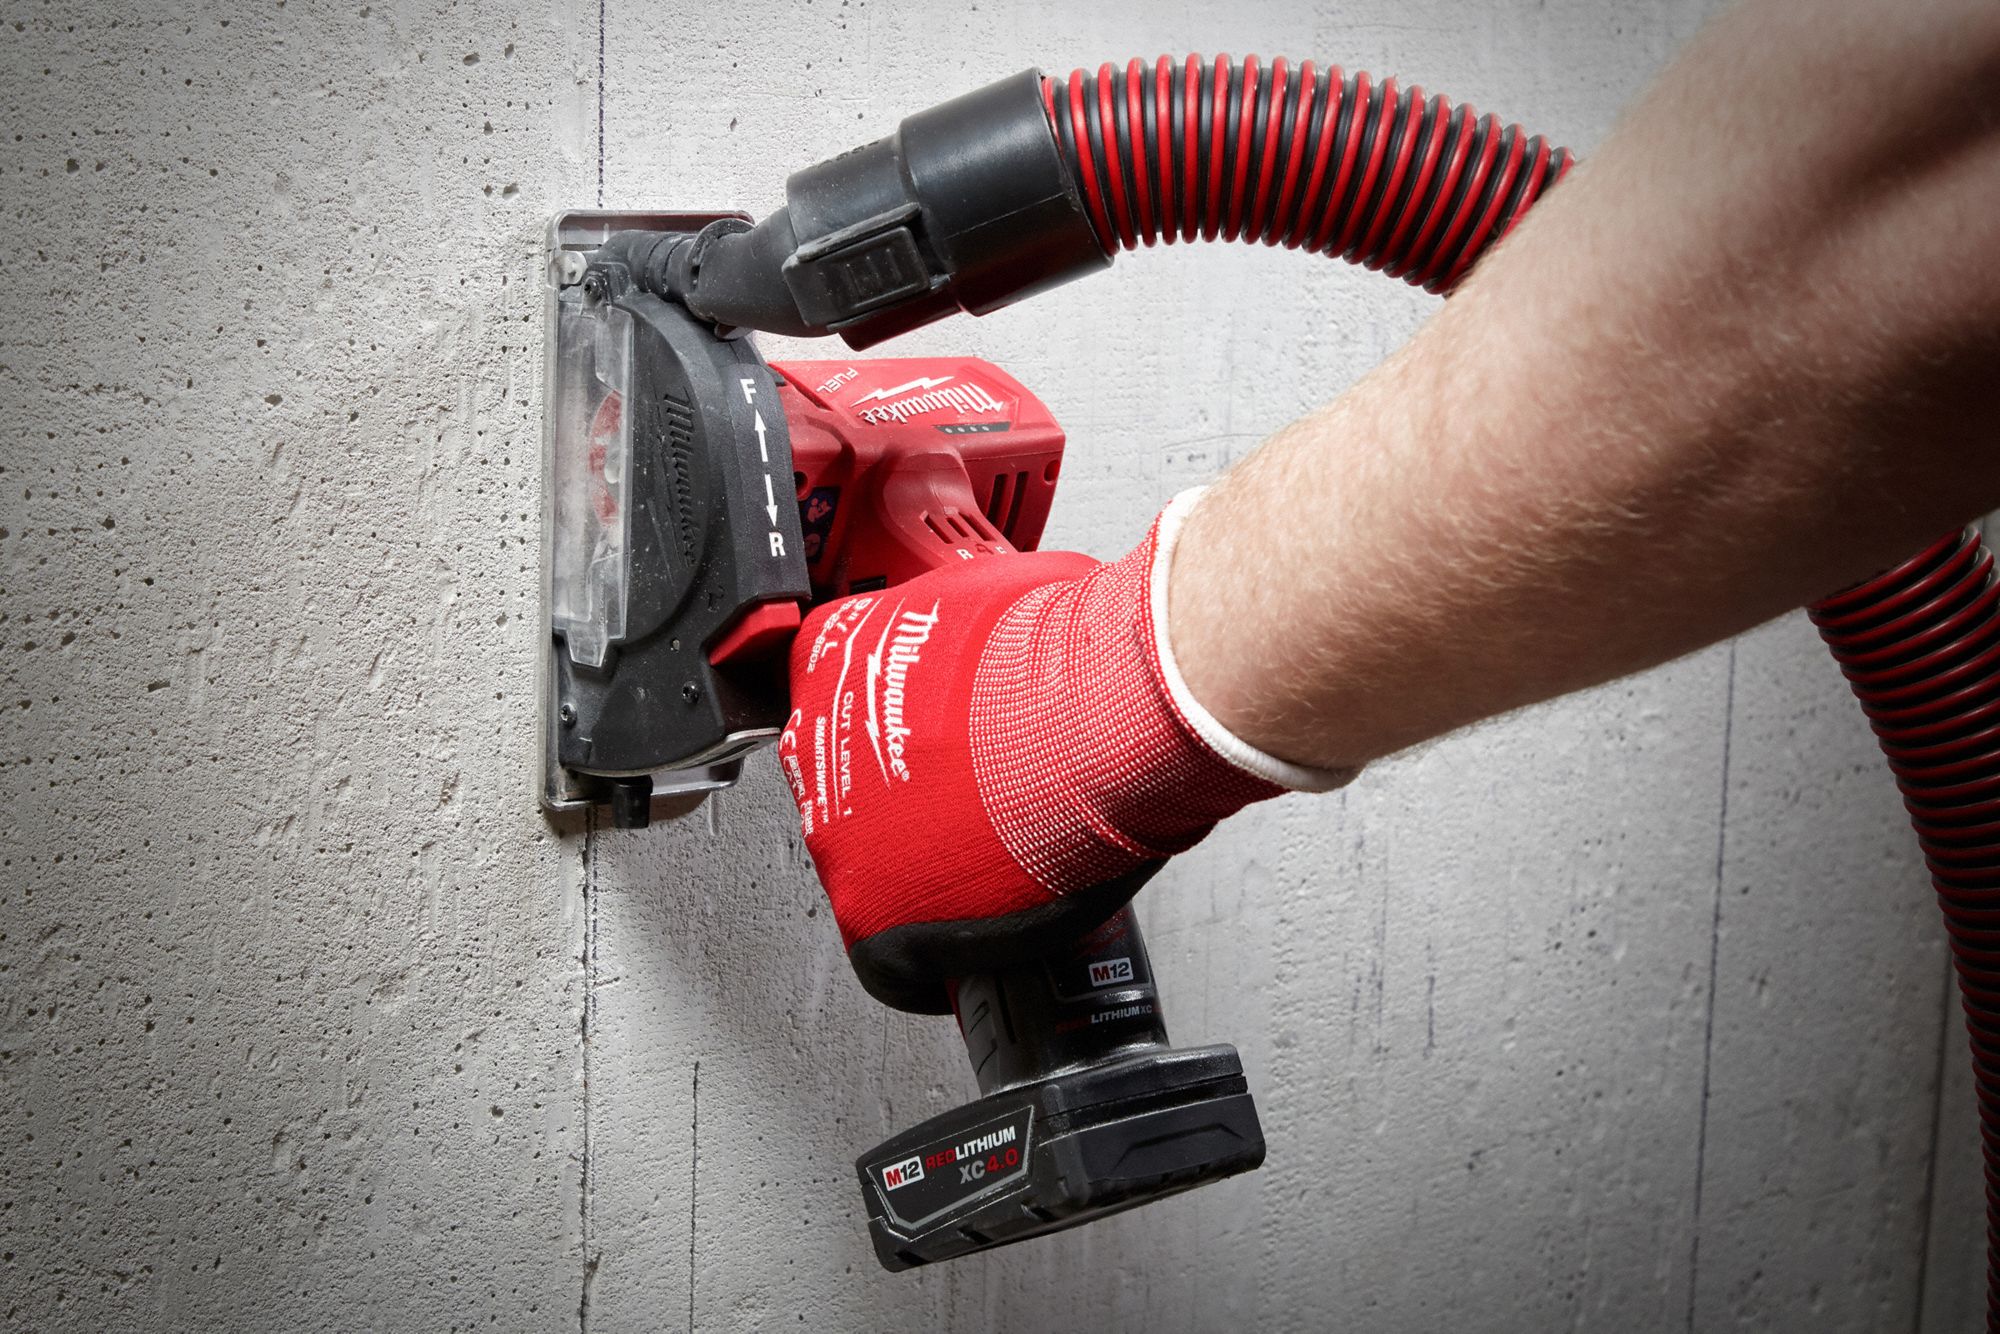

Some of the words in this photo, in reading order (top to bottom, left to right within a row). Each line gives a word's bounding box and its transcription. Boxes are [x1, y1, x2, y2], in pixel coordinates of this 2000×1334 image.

[739, 378, 757, 404] F
[816, 367, 859, 394] FUEL
[858, 381, 1004, 426] Milwaukee
[768, 531, 787, 557] R
[955, 548, 975, 560] R
[840, 691, 854, 730] CUT
[840, 738, 854, 799] LEVEL
[1091, 961, 1131, 982] M12
[885, 1160, 921, 1188] M12
